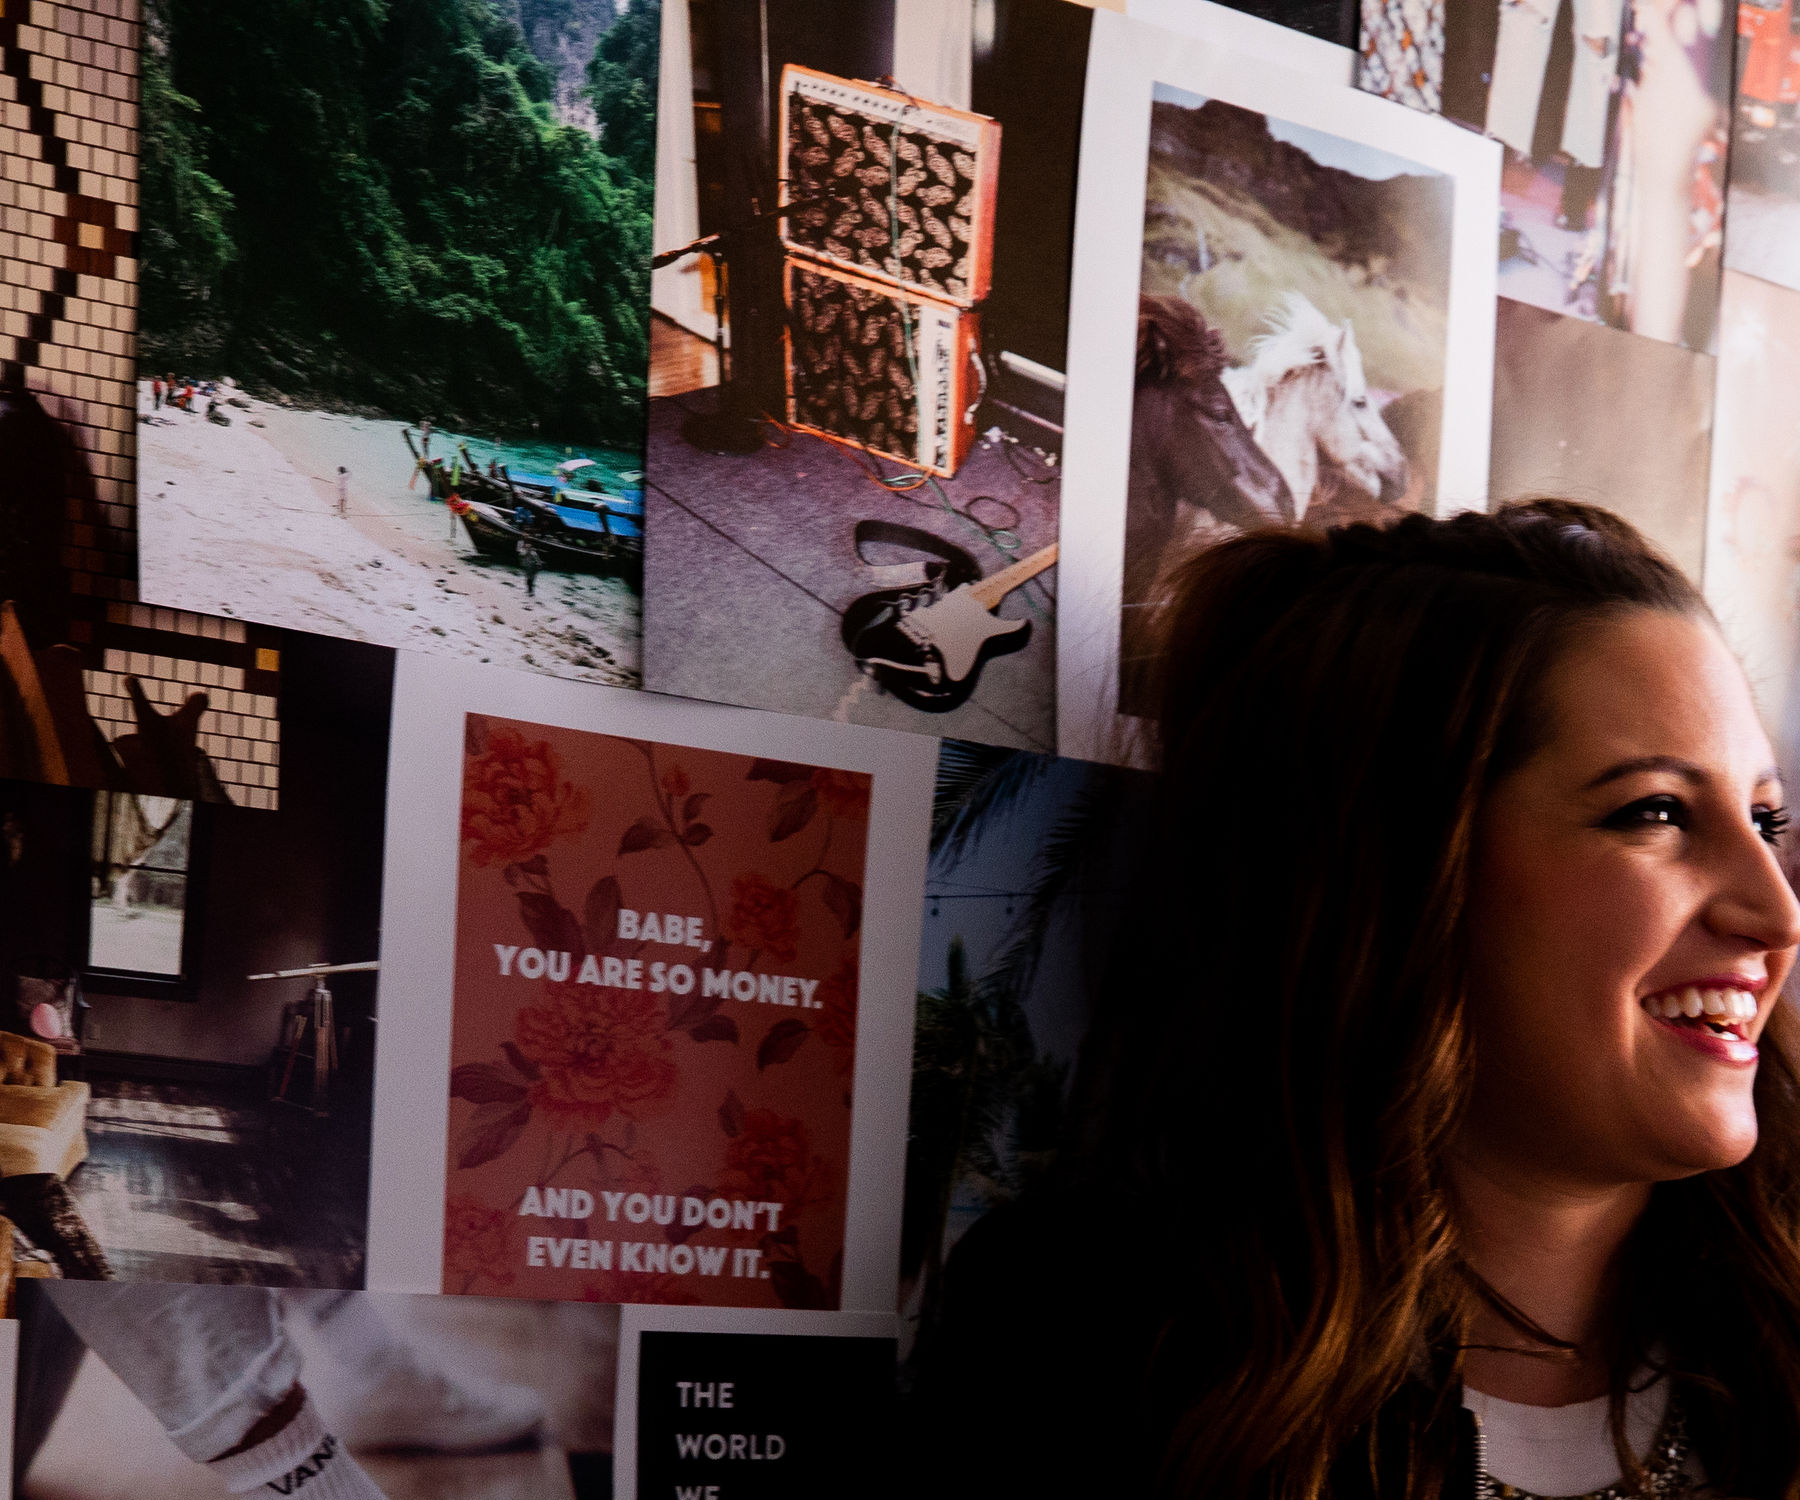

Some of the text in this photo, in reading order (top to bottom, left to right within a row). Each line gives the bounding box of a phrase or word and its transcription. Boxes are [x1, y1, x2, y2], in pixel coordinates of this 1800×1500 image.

[617, 909, 713, 952] BABE,
[494, 944, 824, 1009] YOU ARE SO MONEY.
[518, 1186, 784, 1231] AND YOU DON'T
[527, 1237, 771, 1279] EVEN KNOW IT.
[675, 1381, 735, 1409] THE
[674, 1434, 787, 1461] WORLD
